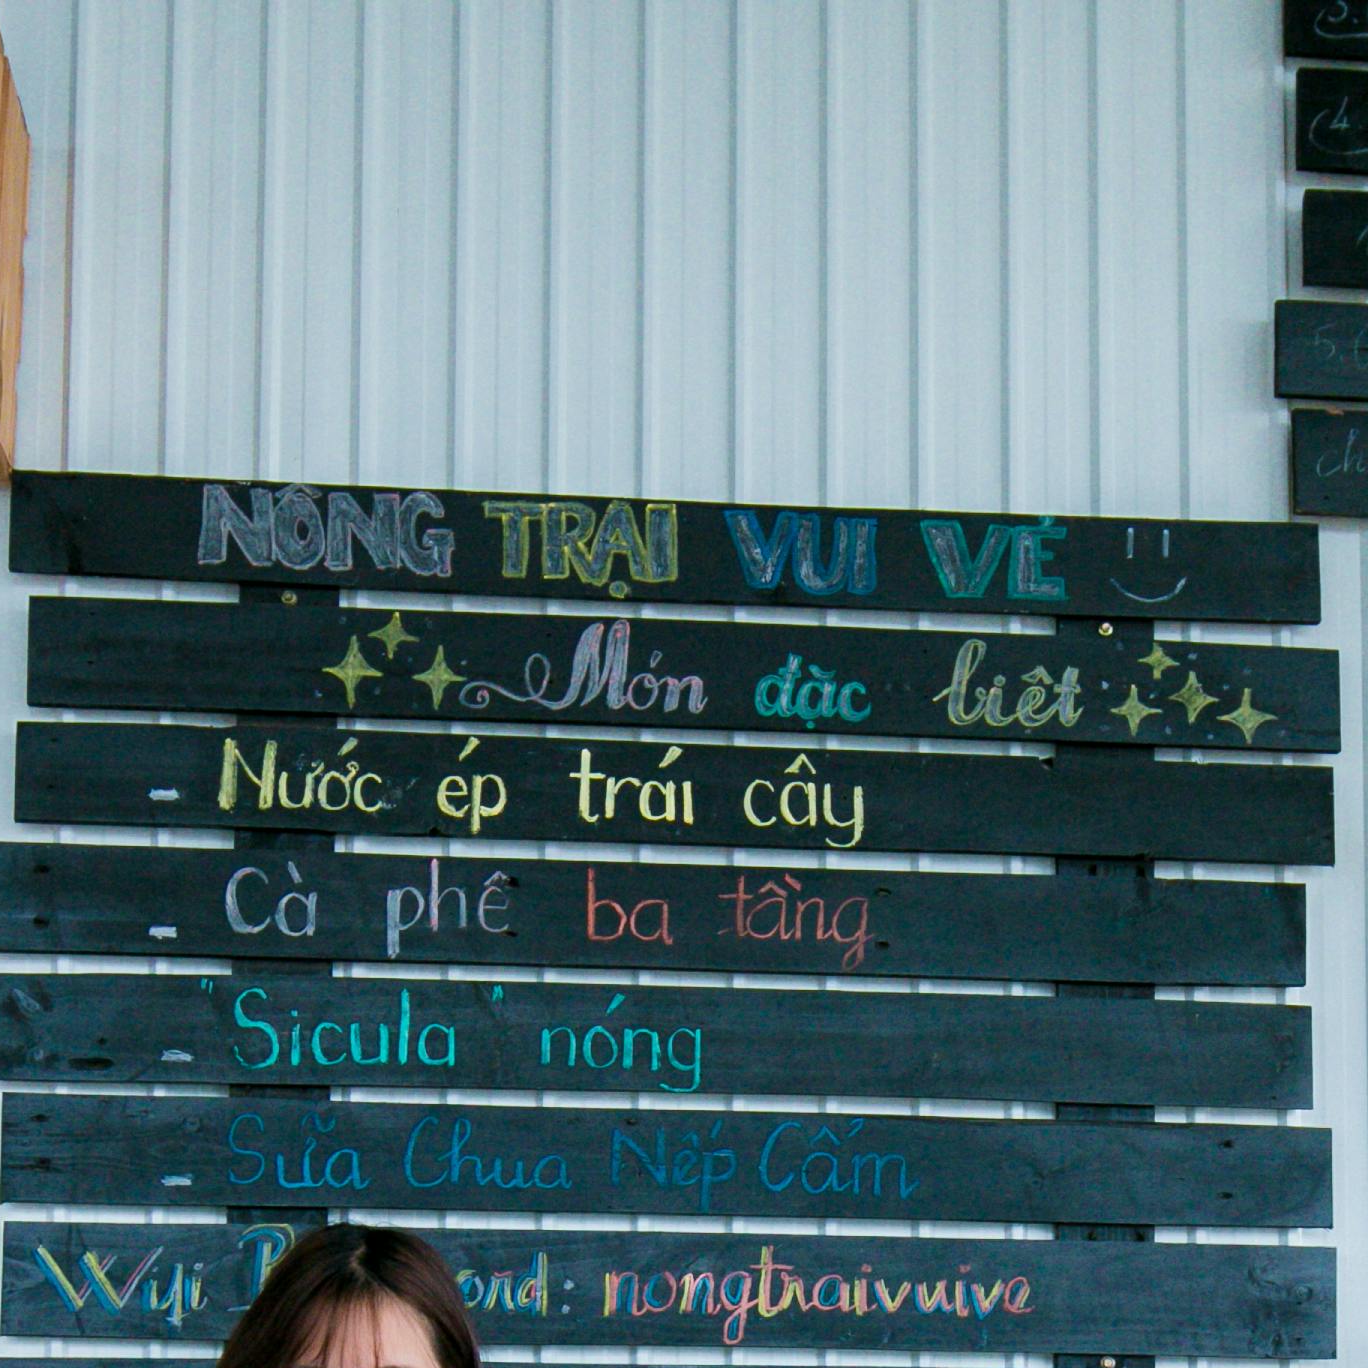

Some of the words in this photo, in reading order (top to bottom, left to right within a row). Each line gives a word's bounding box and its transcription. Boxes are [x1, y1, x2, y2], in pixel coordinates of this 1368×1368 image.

[197, 482, 454, 578] NÔNG
[483, 498, 678, 600] TRẠI
[723, 510, 878, 596] VUI
[459, 618, 708, 713] Món
[753, 651, 872, 730] đặc
[217, 736, 383, 813] Nước
[436, 737, 508, 834] ép
[569, 745, 695, 826] trái
[742, 752, 866, 848] cây
[225, 860, 318, 938] Cà
[386, 857, 512, 958] phê
[586, 866, 674, 945] ba
[718, 872, 875, 972] tầng
[539, 992, 703, 1093] nóng
[227, 1101, 372, 1190] Sữa
[609, 1118, 737, 1213] Nếp
[603, 1244, 1036, 1346] nongtraivuive
